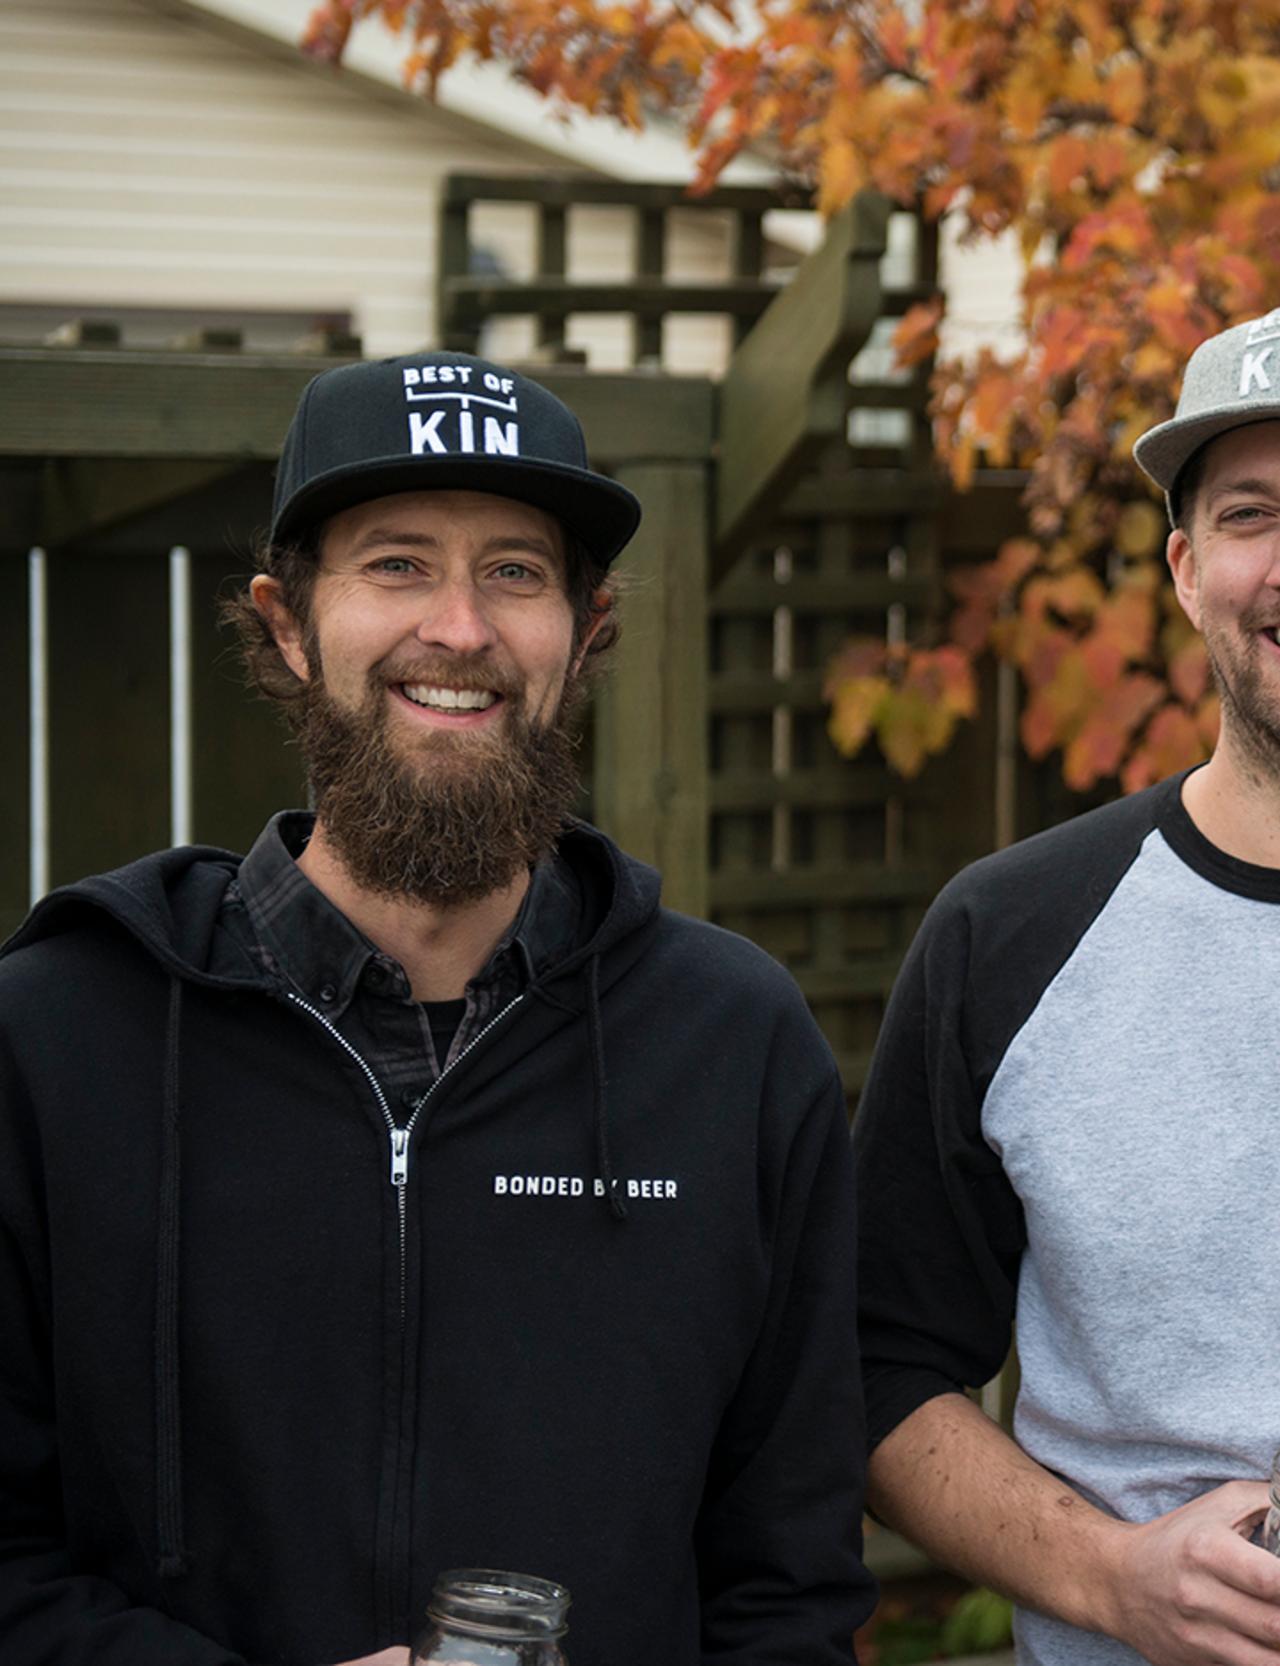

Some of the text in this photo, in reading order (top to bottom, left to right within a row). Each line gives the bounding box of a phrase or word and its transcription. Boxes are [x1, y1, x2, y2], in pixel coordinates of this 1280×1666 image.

[403, 366, 514, 395] BEST OF
[408, 410, 518, 456] KIN
[494, 1176, 677, 1198] BONDED B BEER
